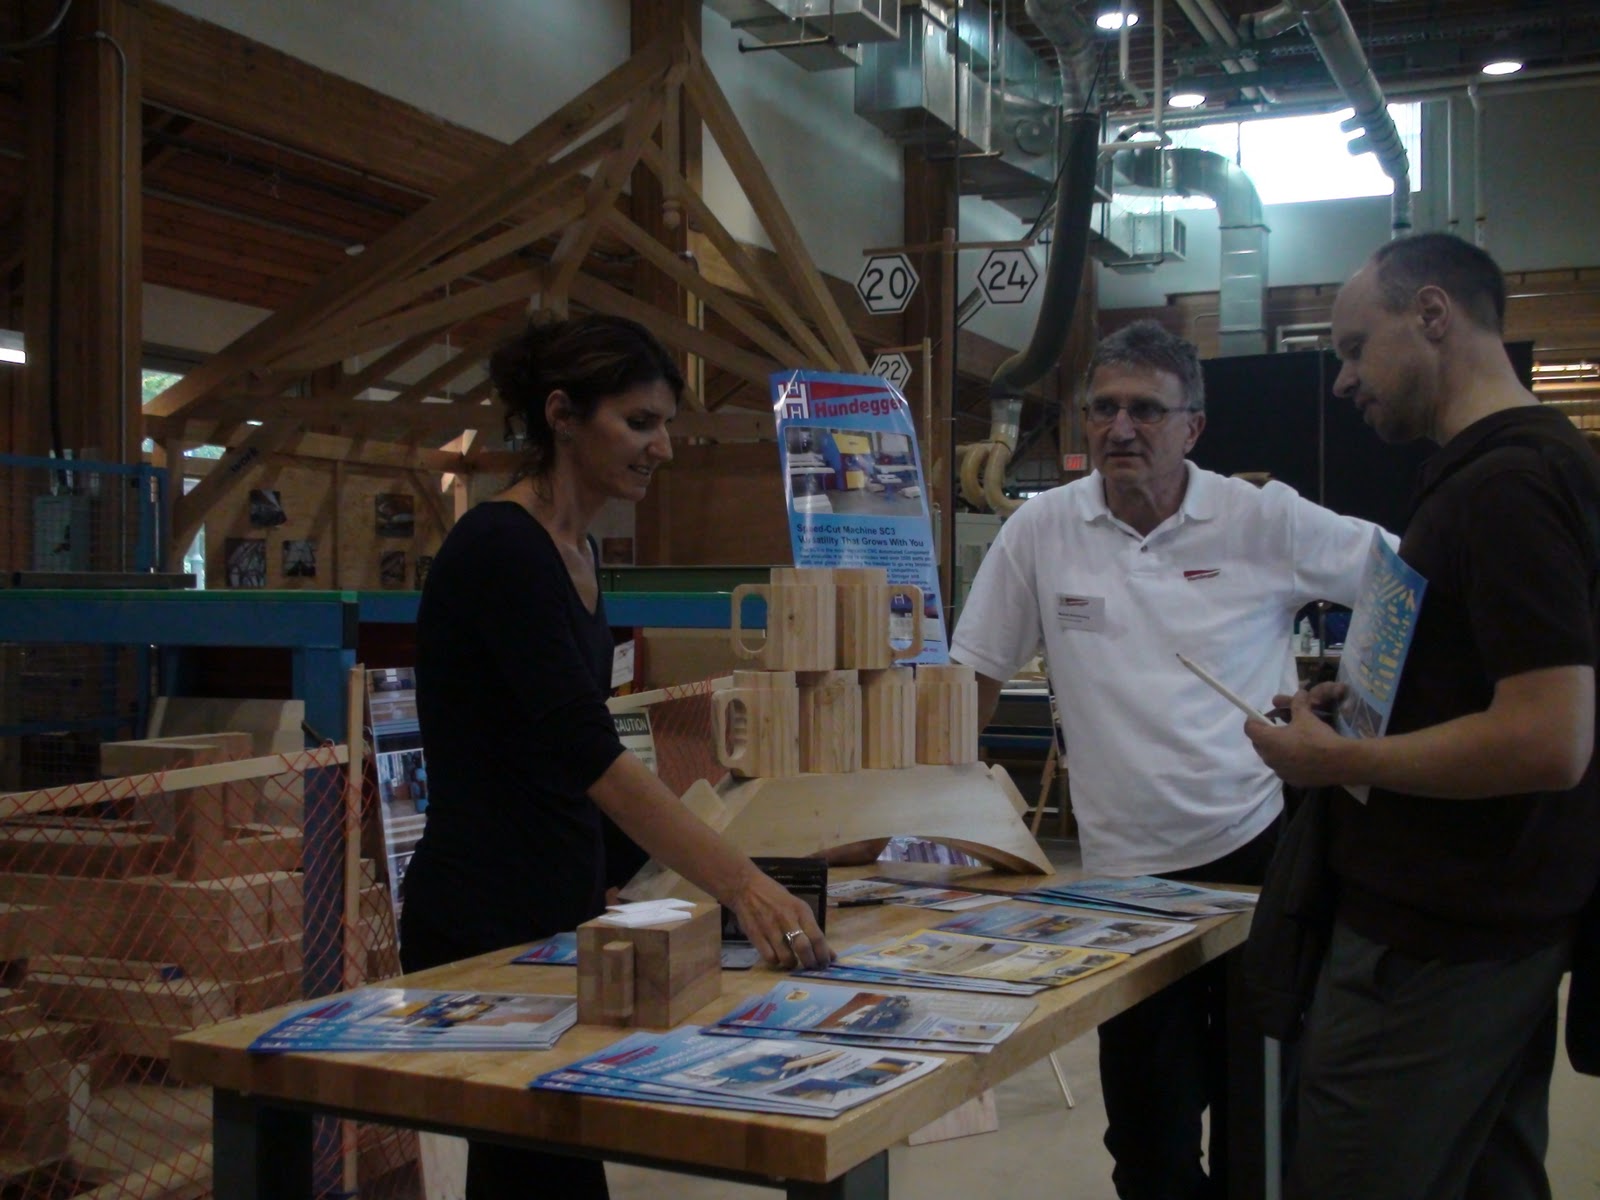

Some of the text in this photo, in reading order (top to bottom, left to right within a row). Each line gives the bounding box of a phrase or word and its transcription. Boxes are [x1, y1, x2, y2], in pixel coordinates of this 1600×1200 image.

[866, 267, 908, 301] 20
[989, 260, 1028, 291] 24
[879, 360, 901, 381] 22
[843, 525, 877, 535] Machine
[879, 527, 896, 536] SC3
[798, 535, 925, 548] Vsatility That Grows With You
[613, 717, 649, 733] CAUTION
